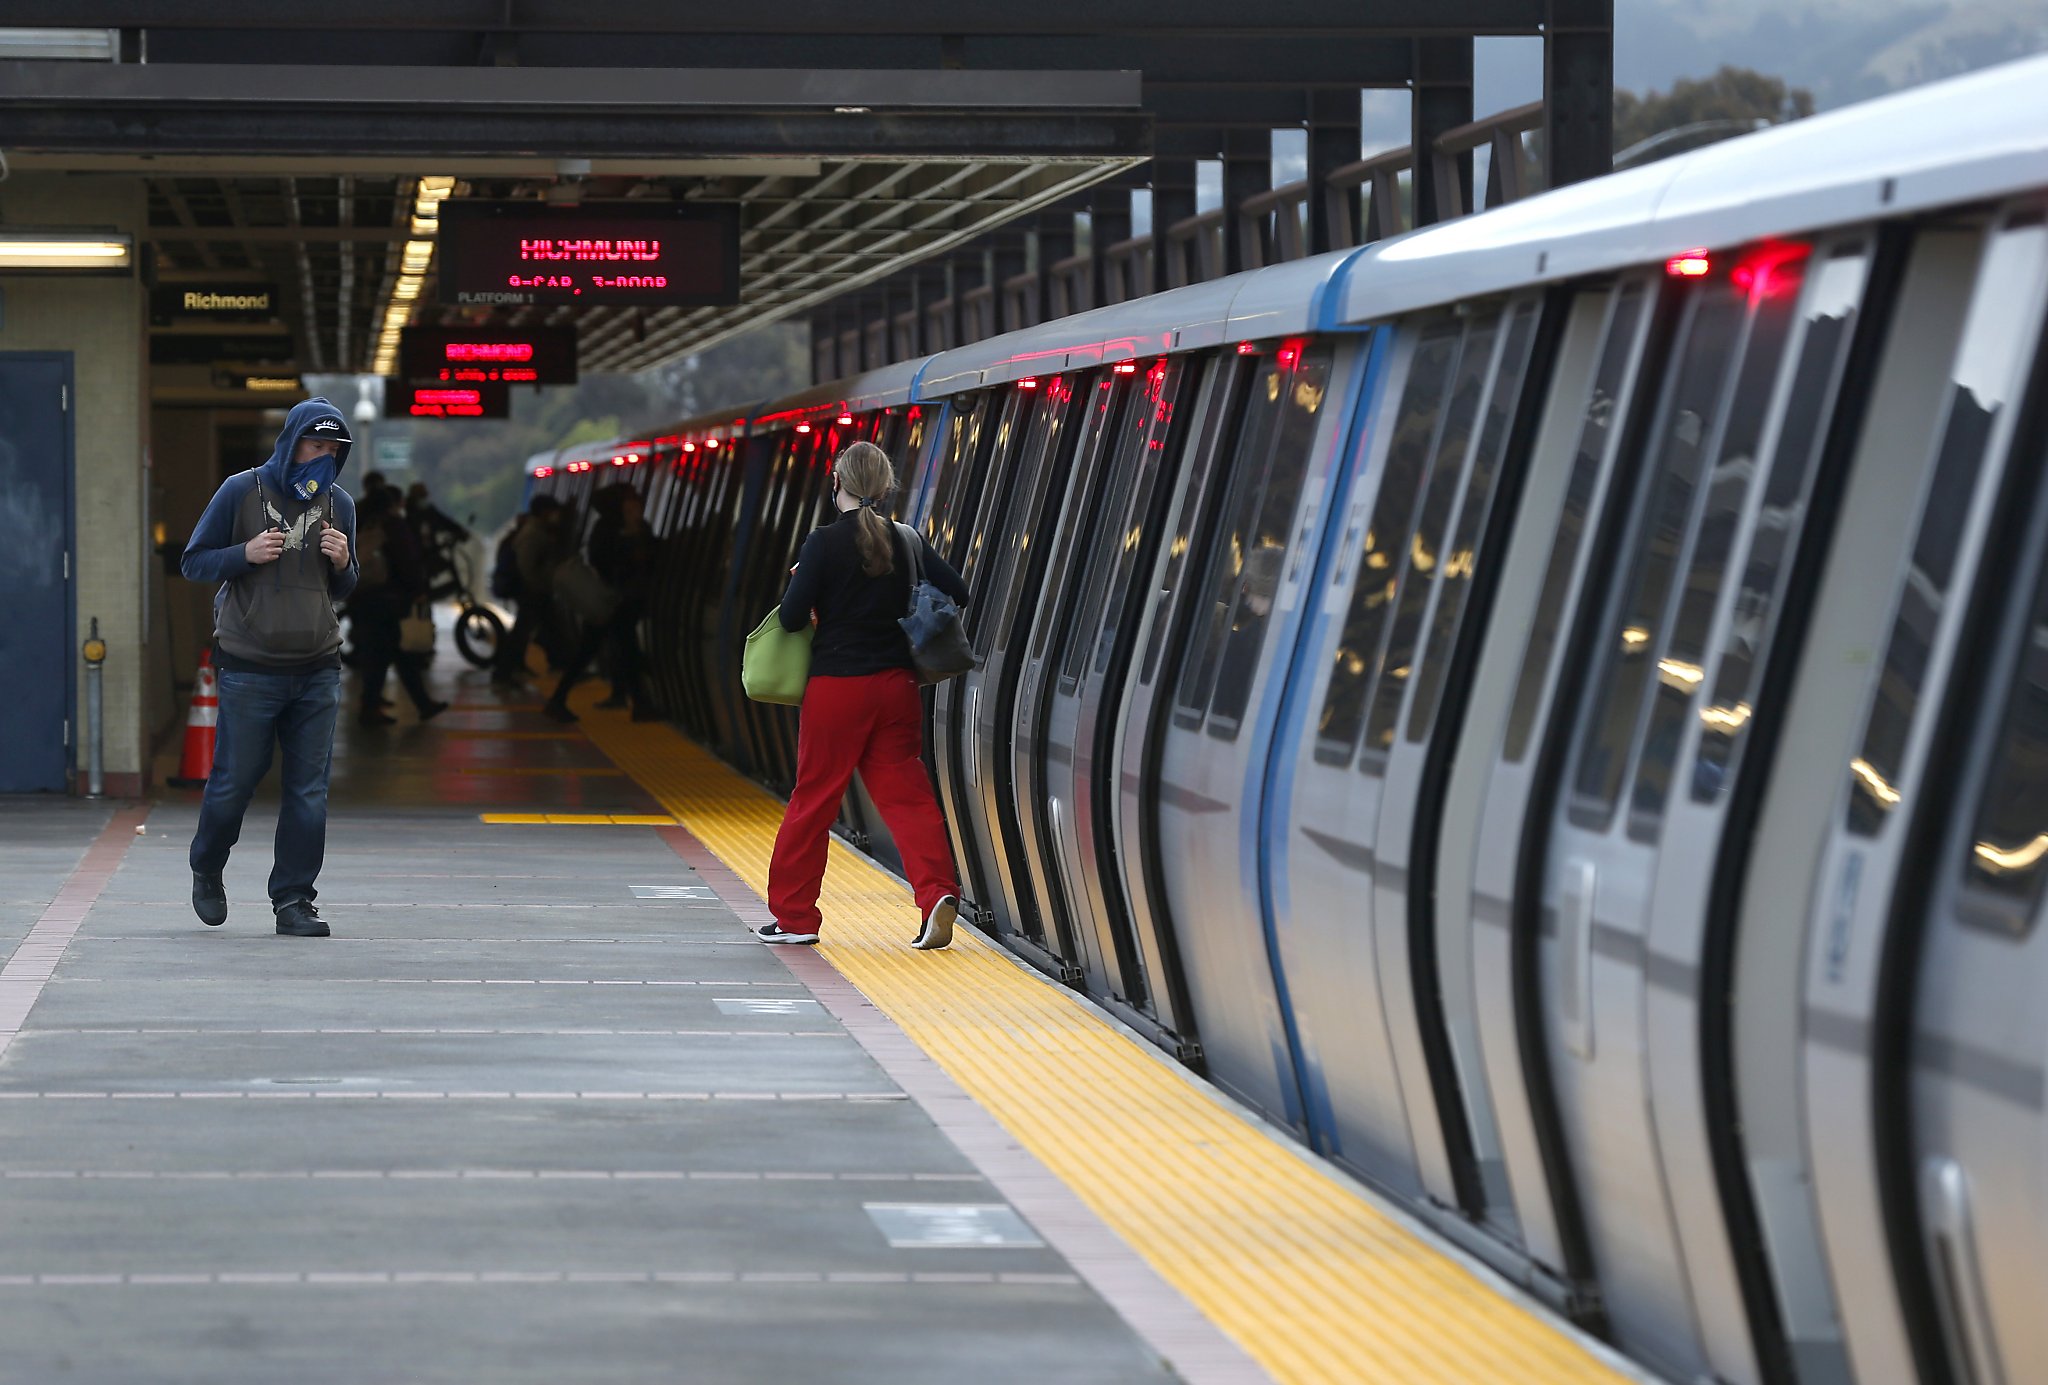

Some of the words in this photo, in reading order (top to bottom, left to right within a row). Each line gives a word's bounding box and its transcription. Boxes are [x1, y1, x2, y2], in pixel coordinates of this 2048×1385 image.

[184, 292, 269, 309] Richmond
[458, 292, 523, 304] PLATFORM
[528, 293, 534, 304] 1
